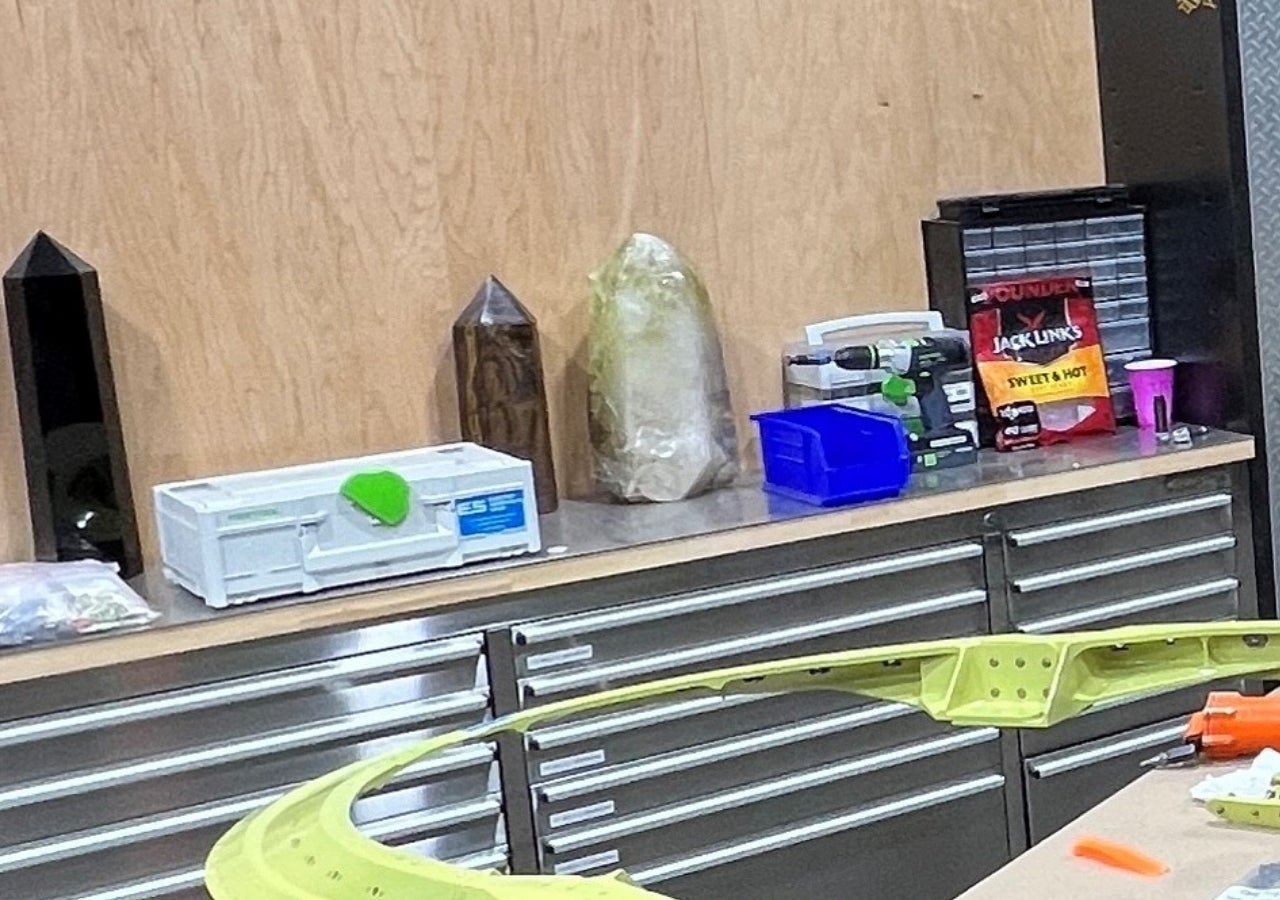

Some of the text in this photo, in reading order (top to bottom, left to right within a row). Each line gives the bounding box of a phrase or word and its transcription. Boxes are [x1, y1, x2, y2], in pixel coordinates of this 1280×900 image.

[993, 332, 1036, 354] JACK
[1007, 373, 1051, 389] SWEET
[1062, 366, 1087, 381] HOT
